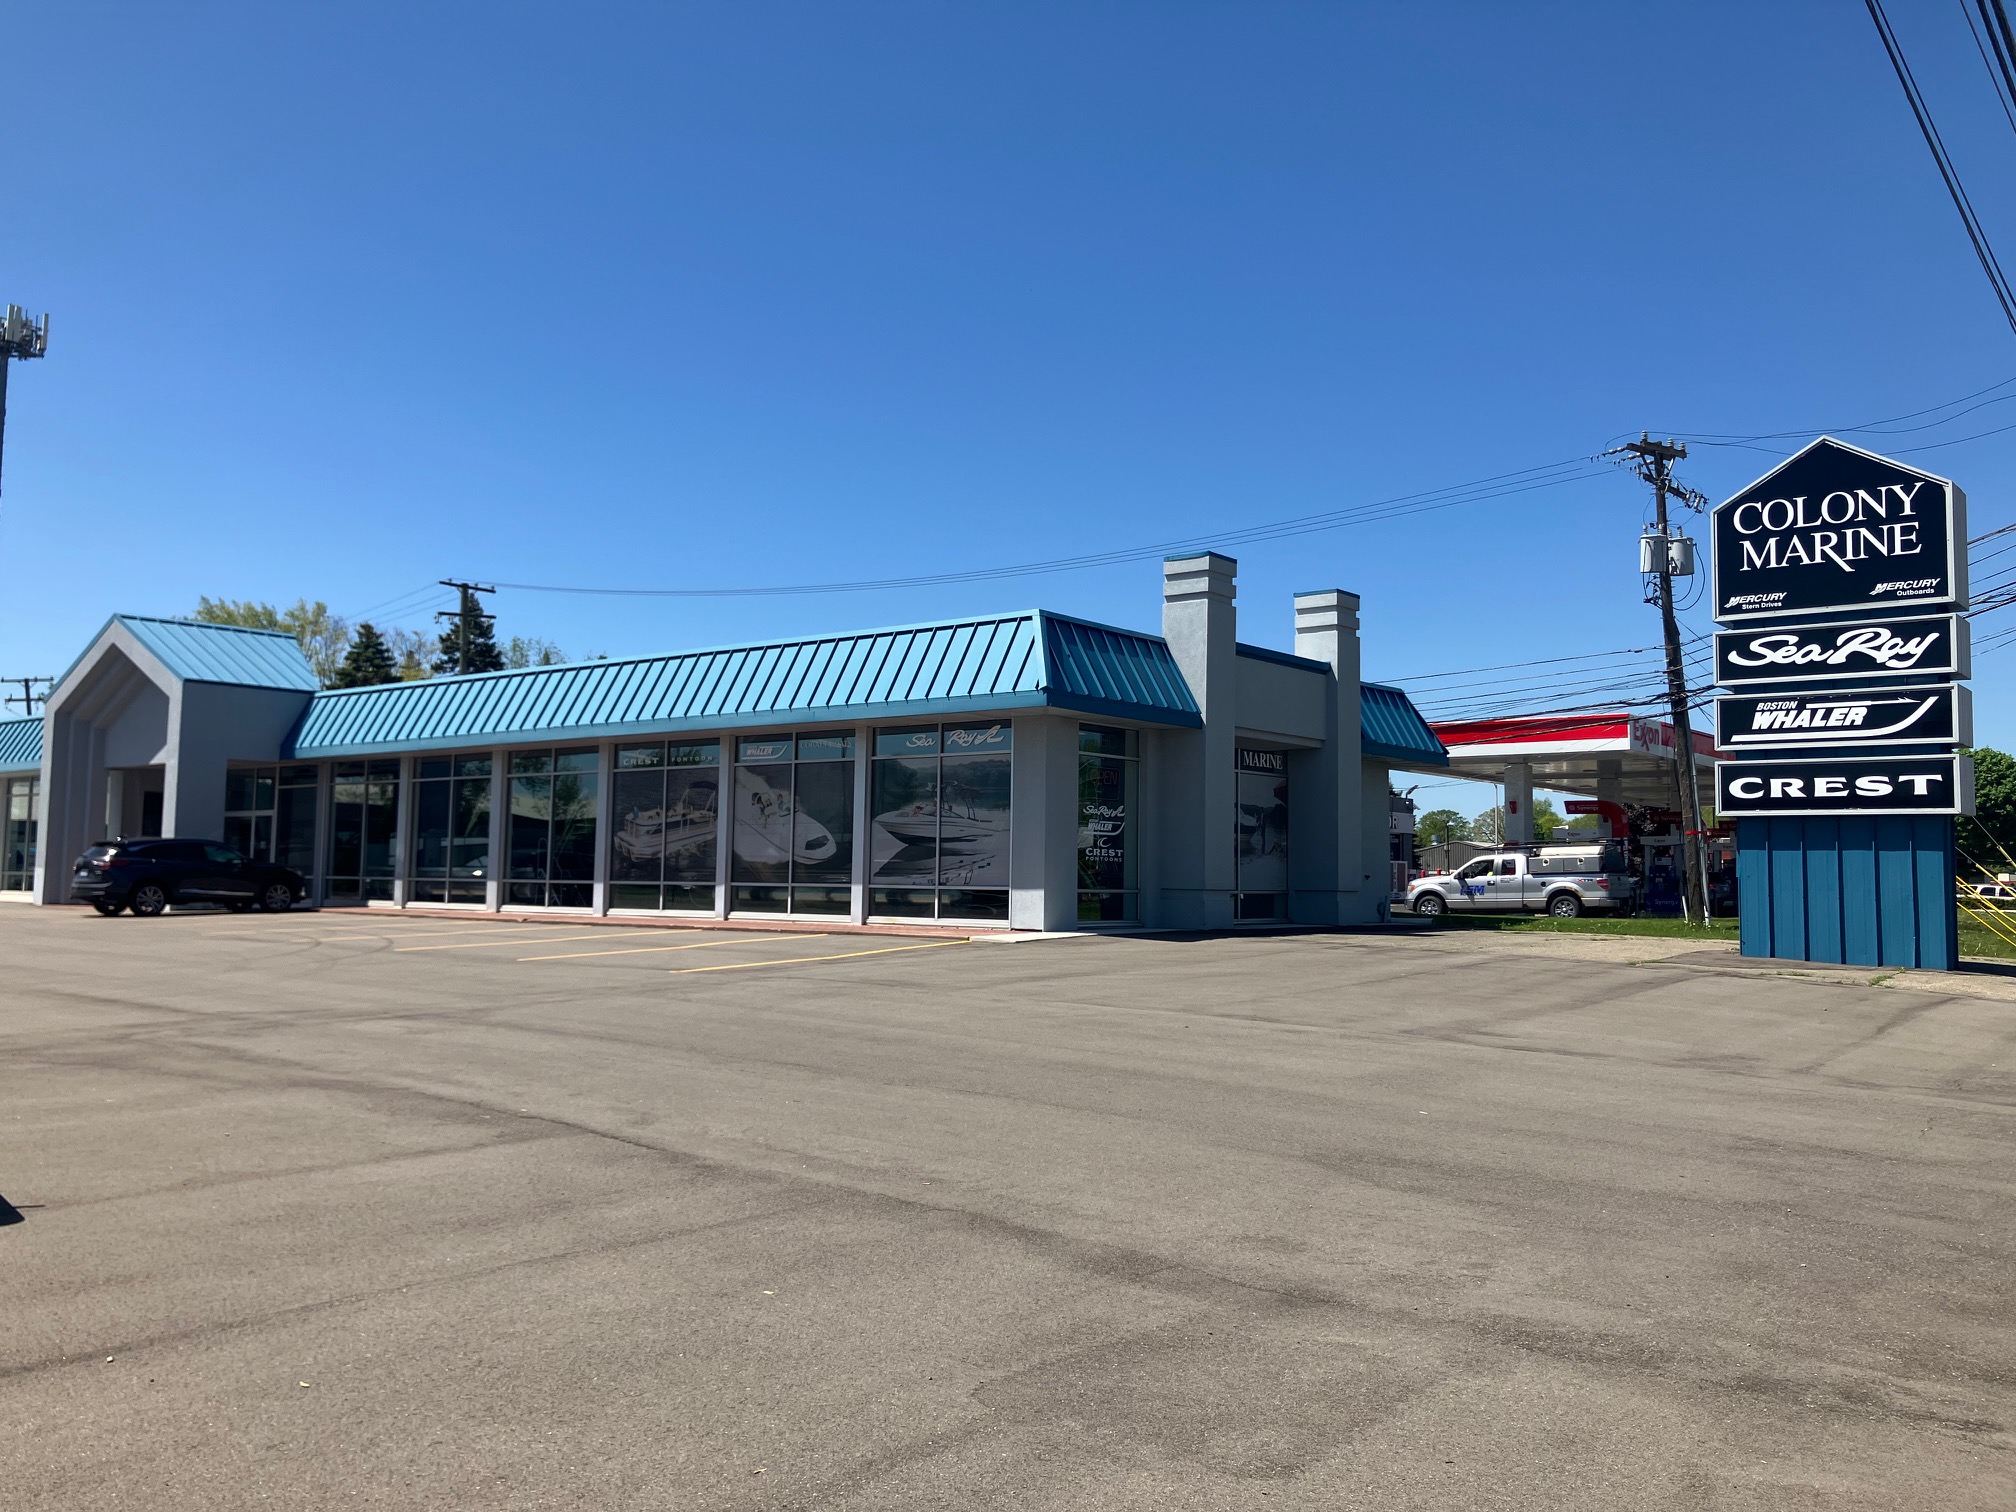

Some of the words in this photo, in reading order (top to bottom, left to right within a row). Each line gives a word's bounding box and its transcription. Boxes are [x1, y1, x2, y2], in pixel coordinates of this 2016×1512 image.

[1733, 482, 1925, 534] COLONY
[1739, 522, 1922, 572] MARINE
[1869, 578, 1941, 595] MERCURY
[1897, 588, 1935, 597] Outboards
[1724, 592, 1787, 608] MERCURY
[1761, 601, 1782, 609] Drives
[1727, 634, 1833, 667] Sea
[1827, 628, 1940, 668] Ray
[1756, 701, 1798, 711] BOSTON
[1751, 707, 1868, 730] WHALER
[906, 734, 936, 748] Sea
[947, 729, 978, 747] Ray
[1634, 720, 1660, 751] Exxon
[746, 747, 773, 756] WHALER
[624, 757, 660, 766] CREST
[1243, 751, 1283, 770] MARINE
[1089, 768, 1118, 785] OPEN
[1729, 774, 1943, 799] CREST
[1088, 822, 1112, 831] WHALER
[1085, 847, 1123, 857] CREST
